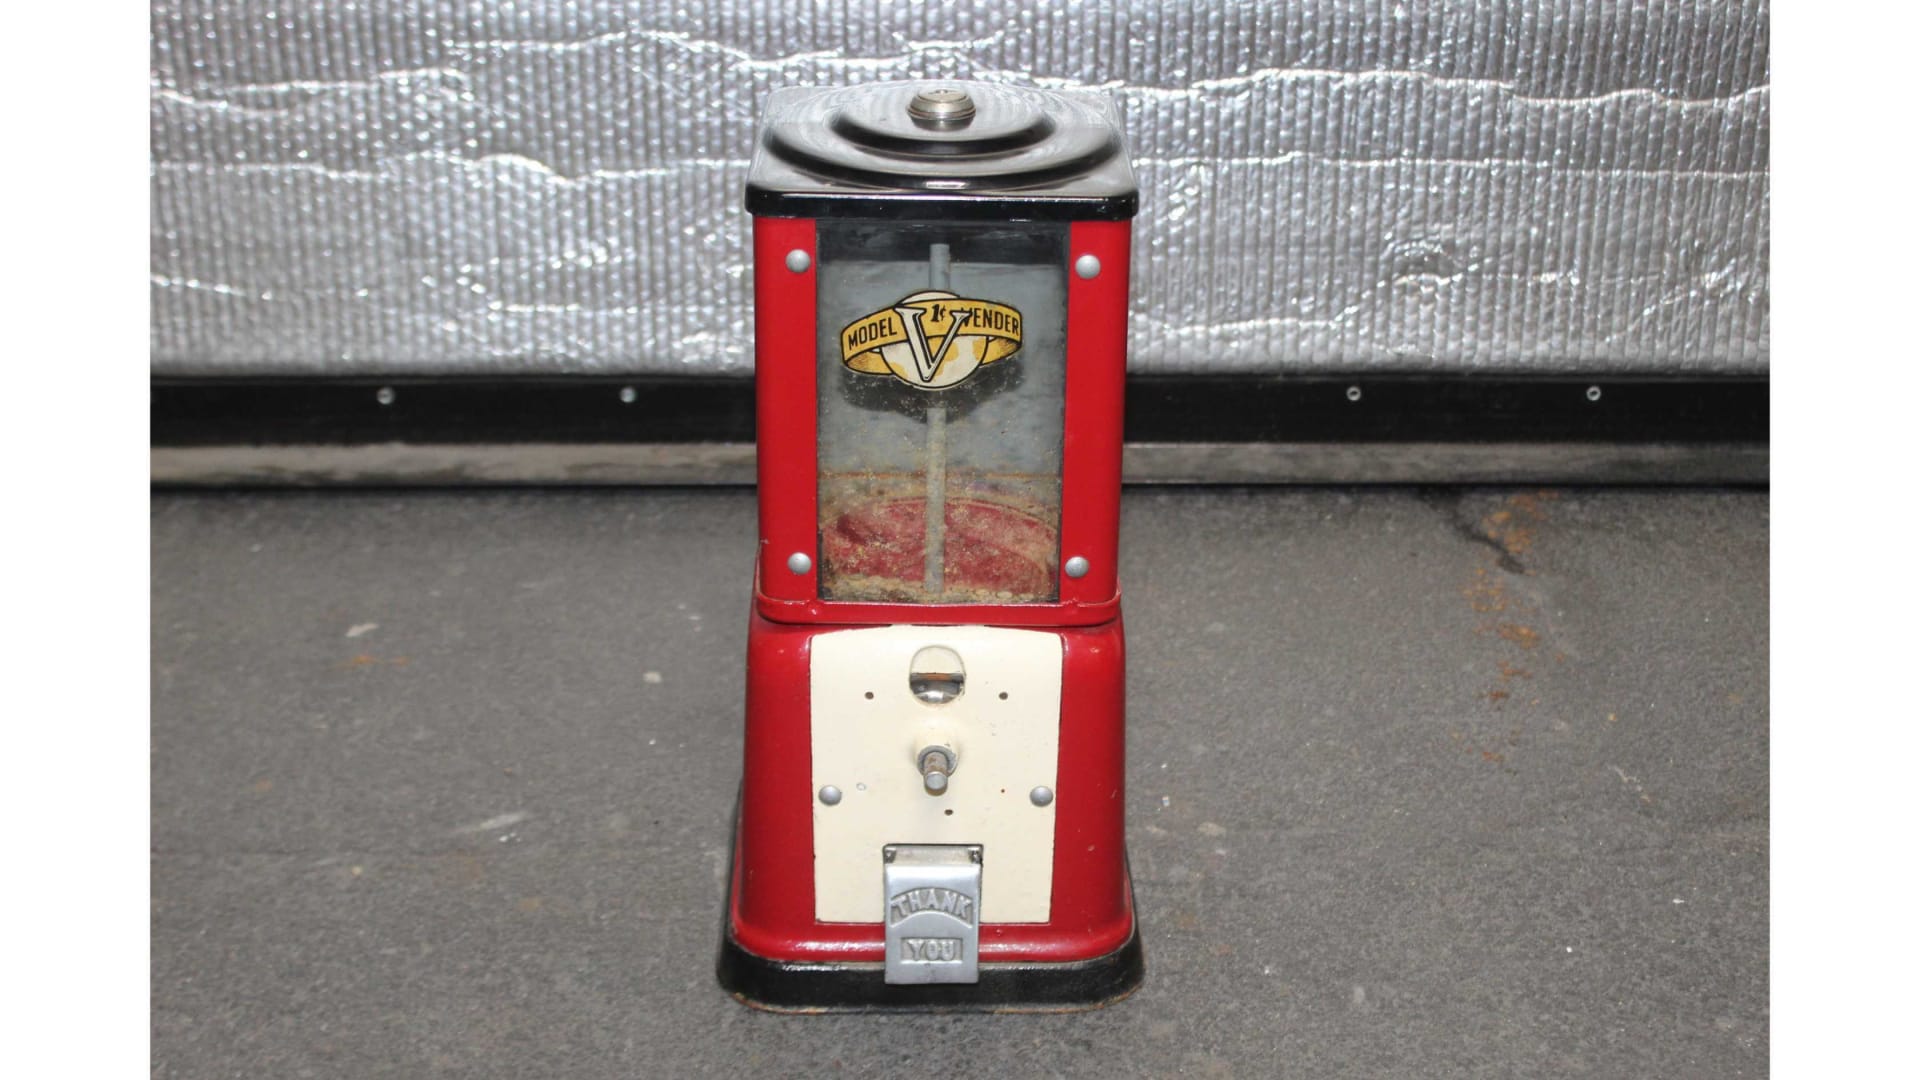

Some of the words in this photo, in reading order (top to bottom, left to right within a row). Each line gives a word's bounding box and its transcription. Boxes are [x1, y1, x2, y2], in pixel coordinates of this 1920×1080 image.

[848, 317, 897, 350] MODEL
[893, 306, 973, 382] V
[891, 888, 972, 919] THANK
[907, 938, 955, 962] YOU
